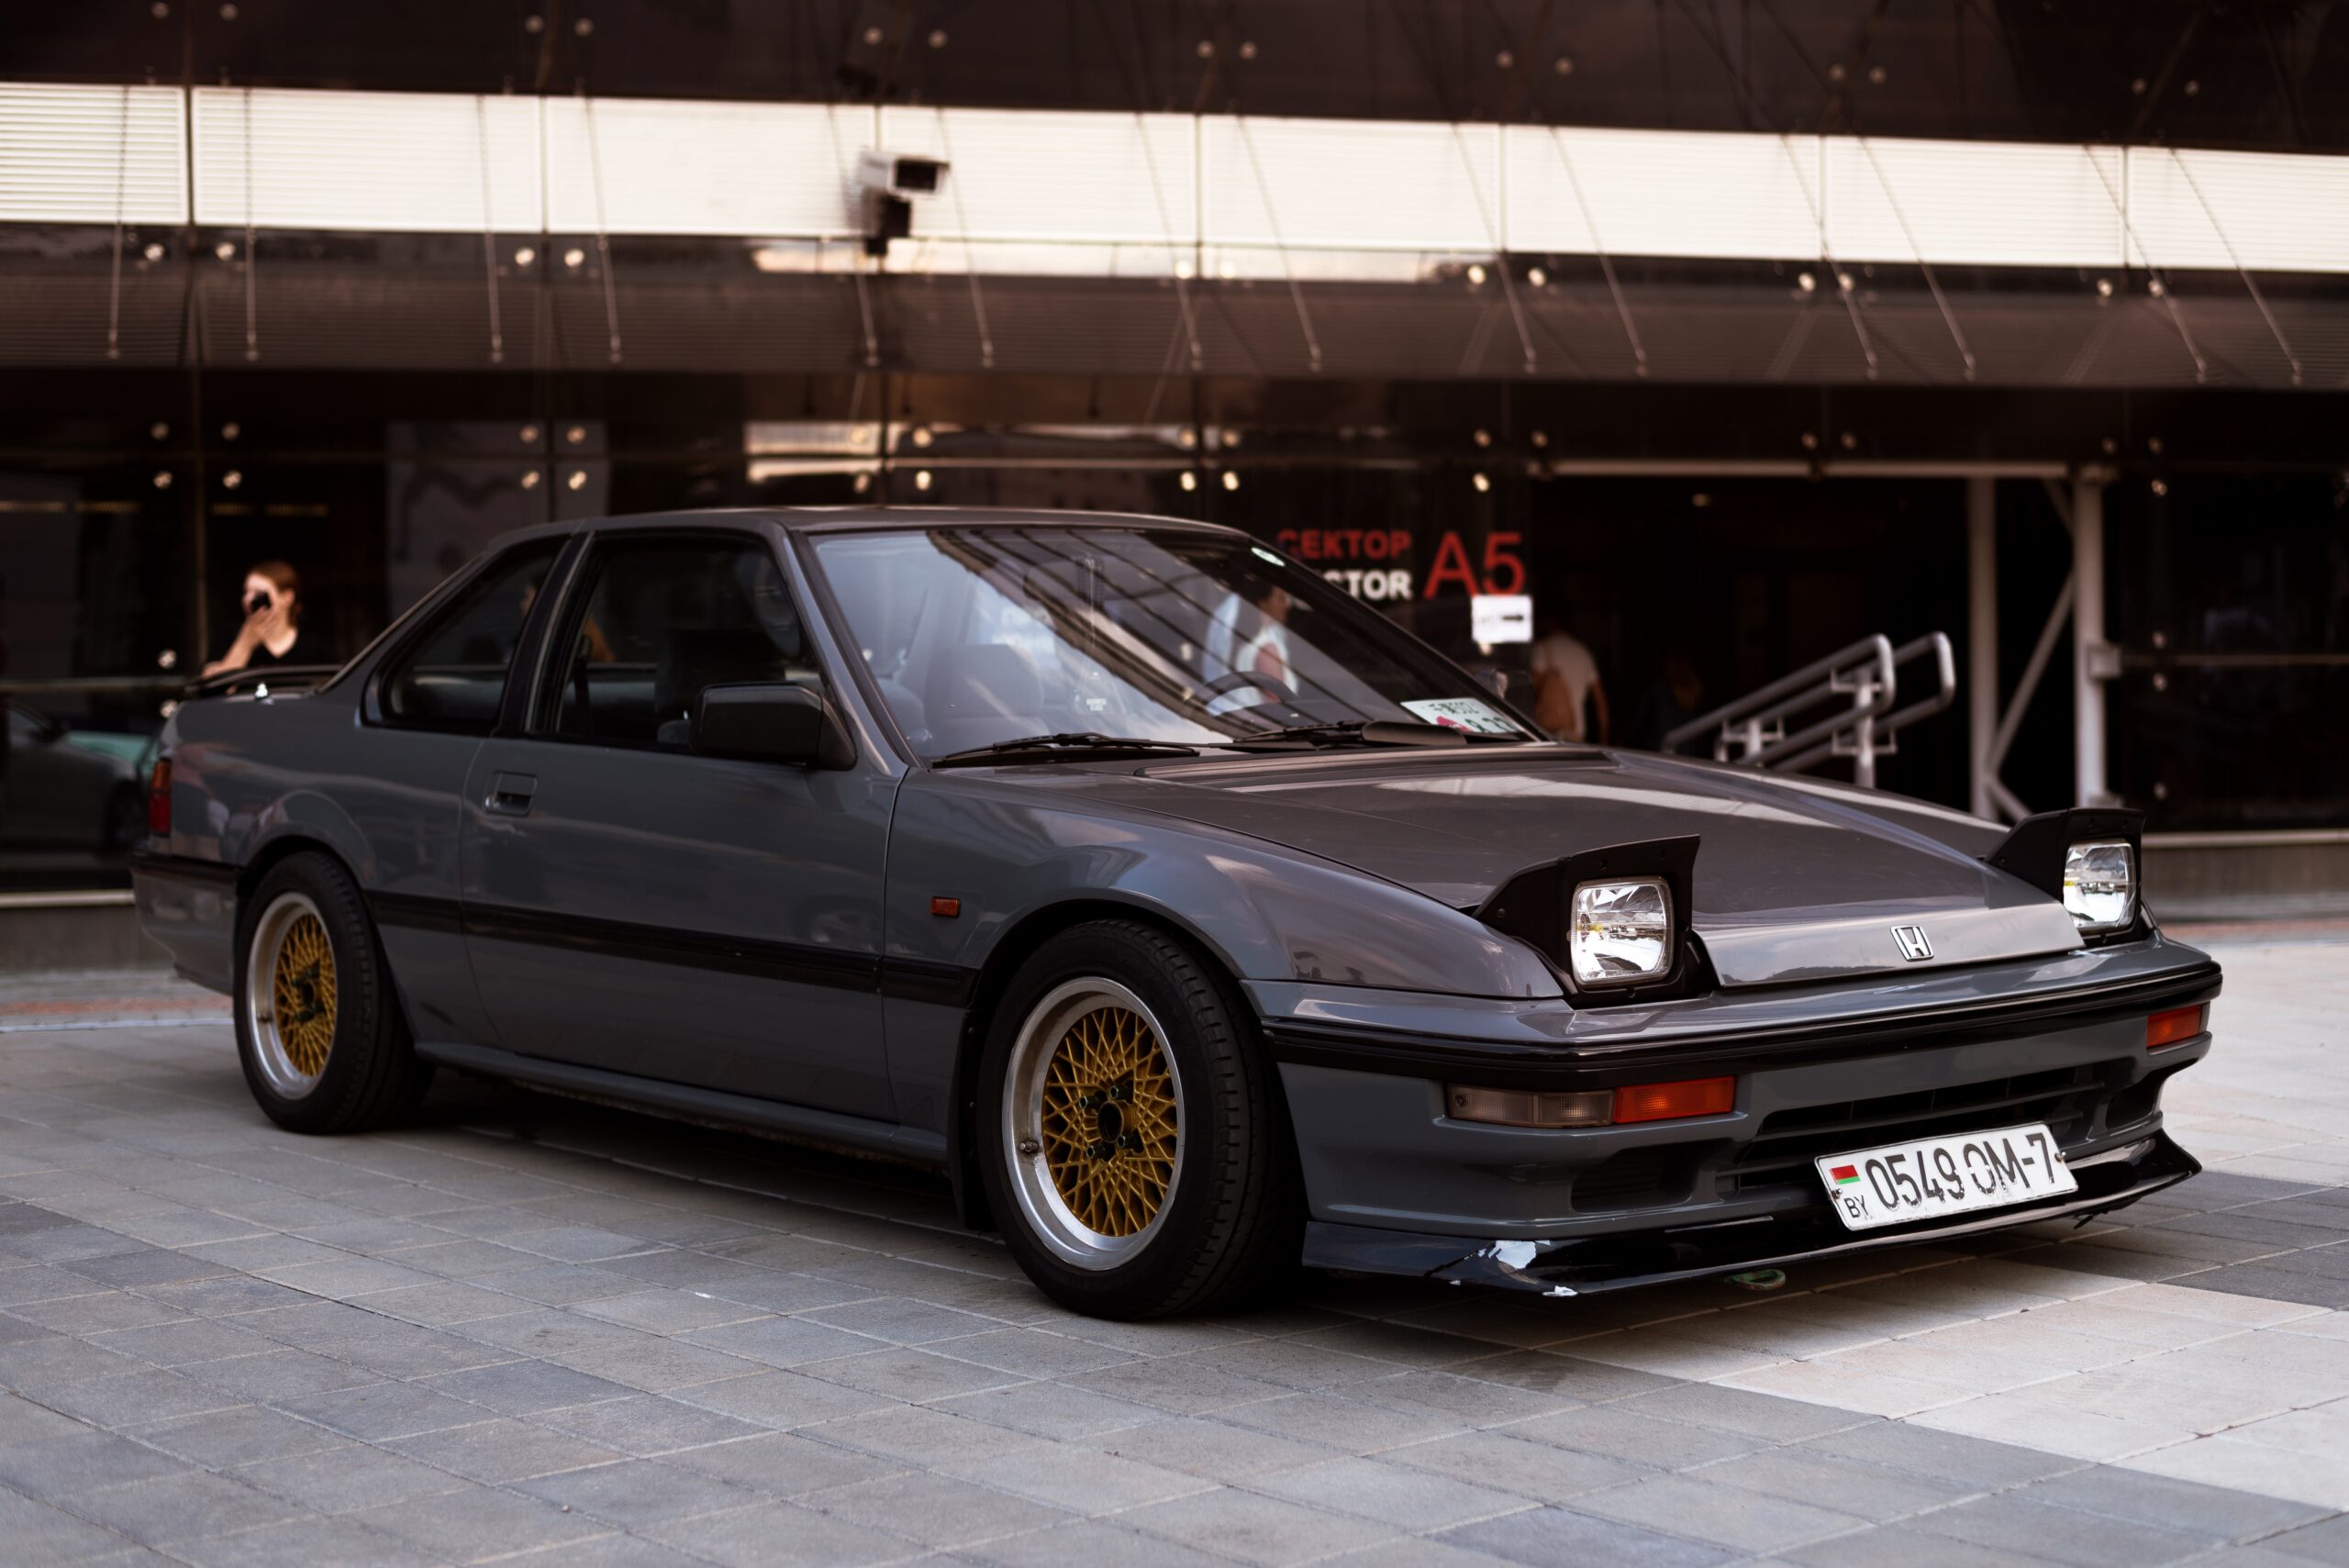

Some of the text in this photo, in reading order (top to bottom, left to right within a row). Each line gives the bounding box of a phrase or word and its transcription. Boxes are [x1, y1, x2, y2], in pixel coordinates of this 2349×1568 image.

[1278, 529, 1412, 560] СЕКТОР
[1865, 1148, 1965, 1211] 0549
[1843, 1195, 1871, 1219] BY
